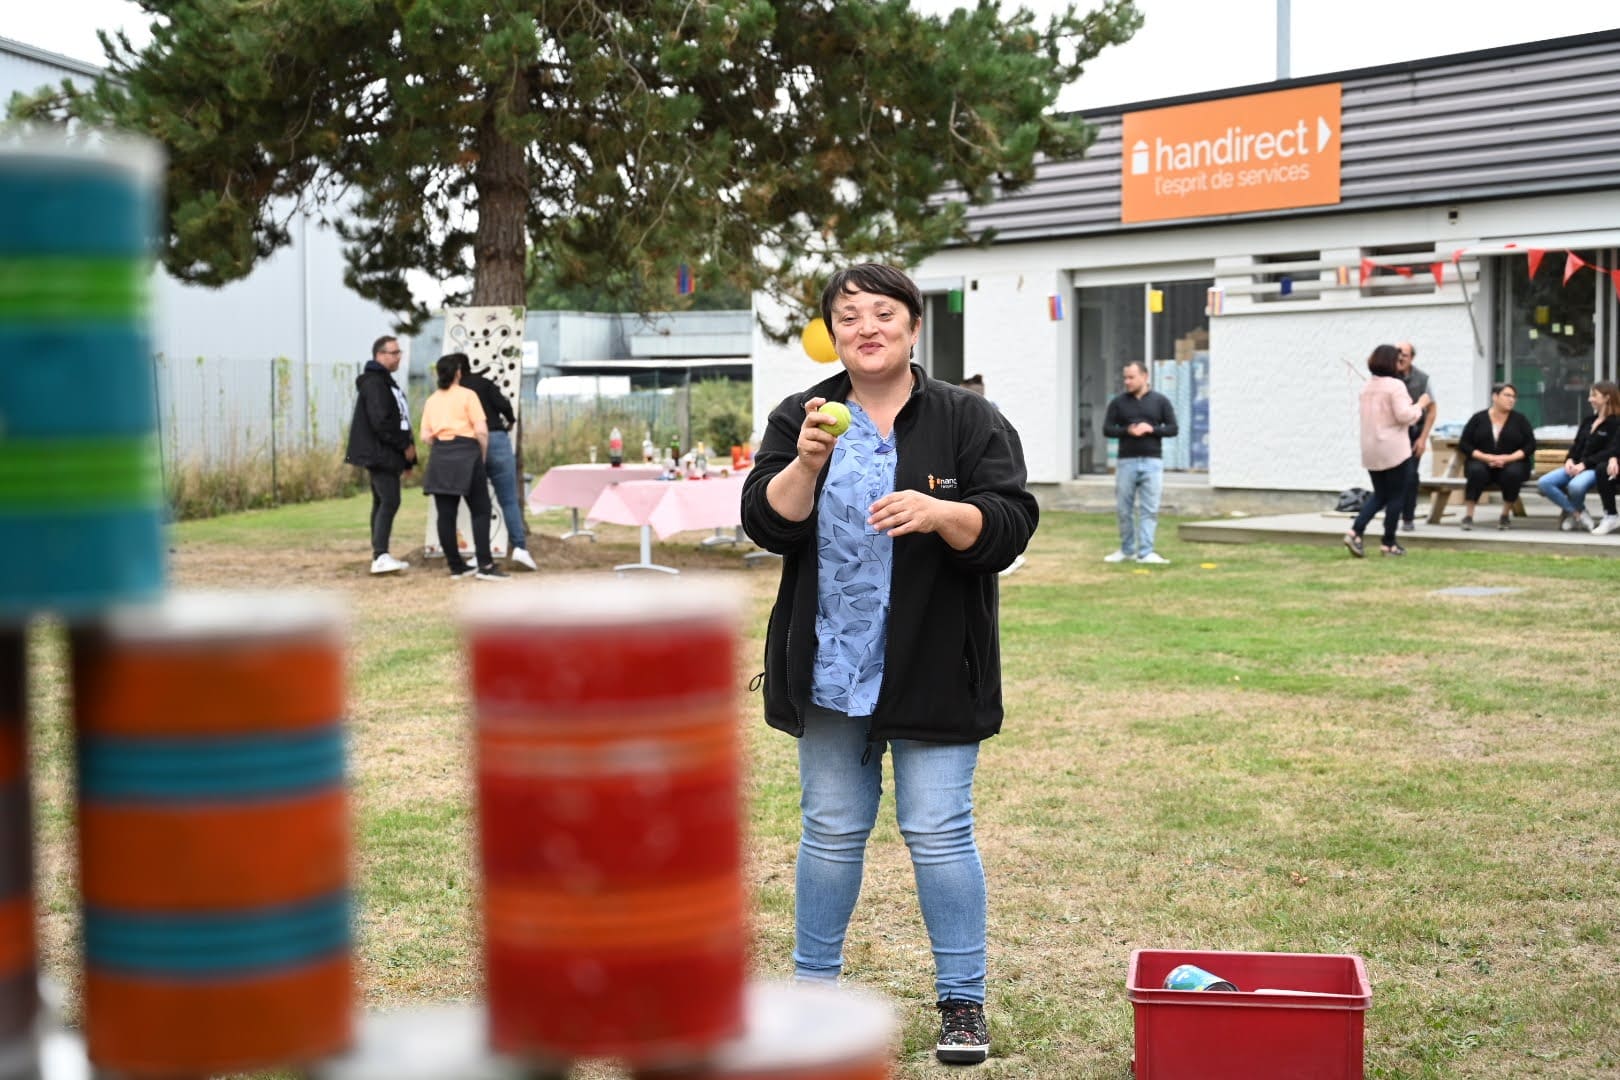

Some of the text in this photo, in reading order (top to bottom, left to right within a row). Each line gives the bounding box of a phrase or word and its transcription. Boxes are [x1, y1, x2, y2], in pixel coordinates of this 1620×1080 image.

[1155, 119, 1309, 172] handirect
[1154, 163, 1310, 197] l'esprit de services
